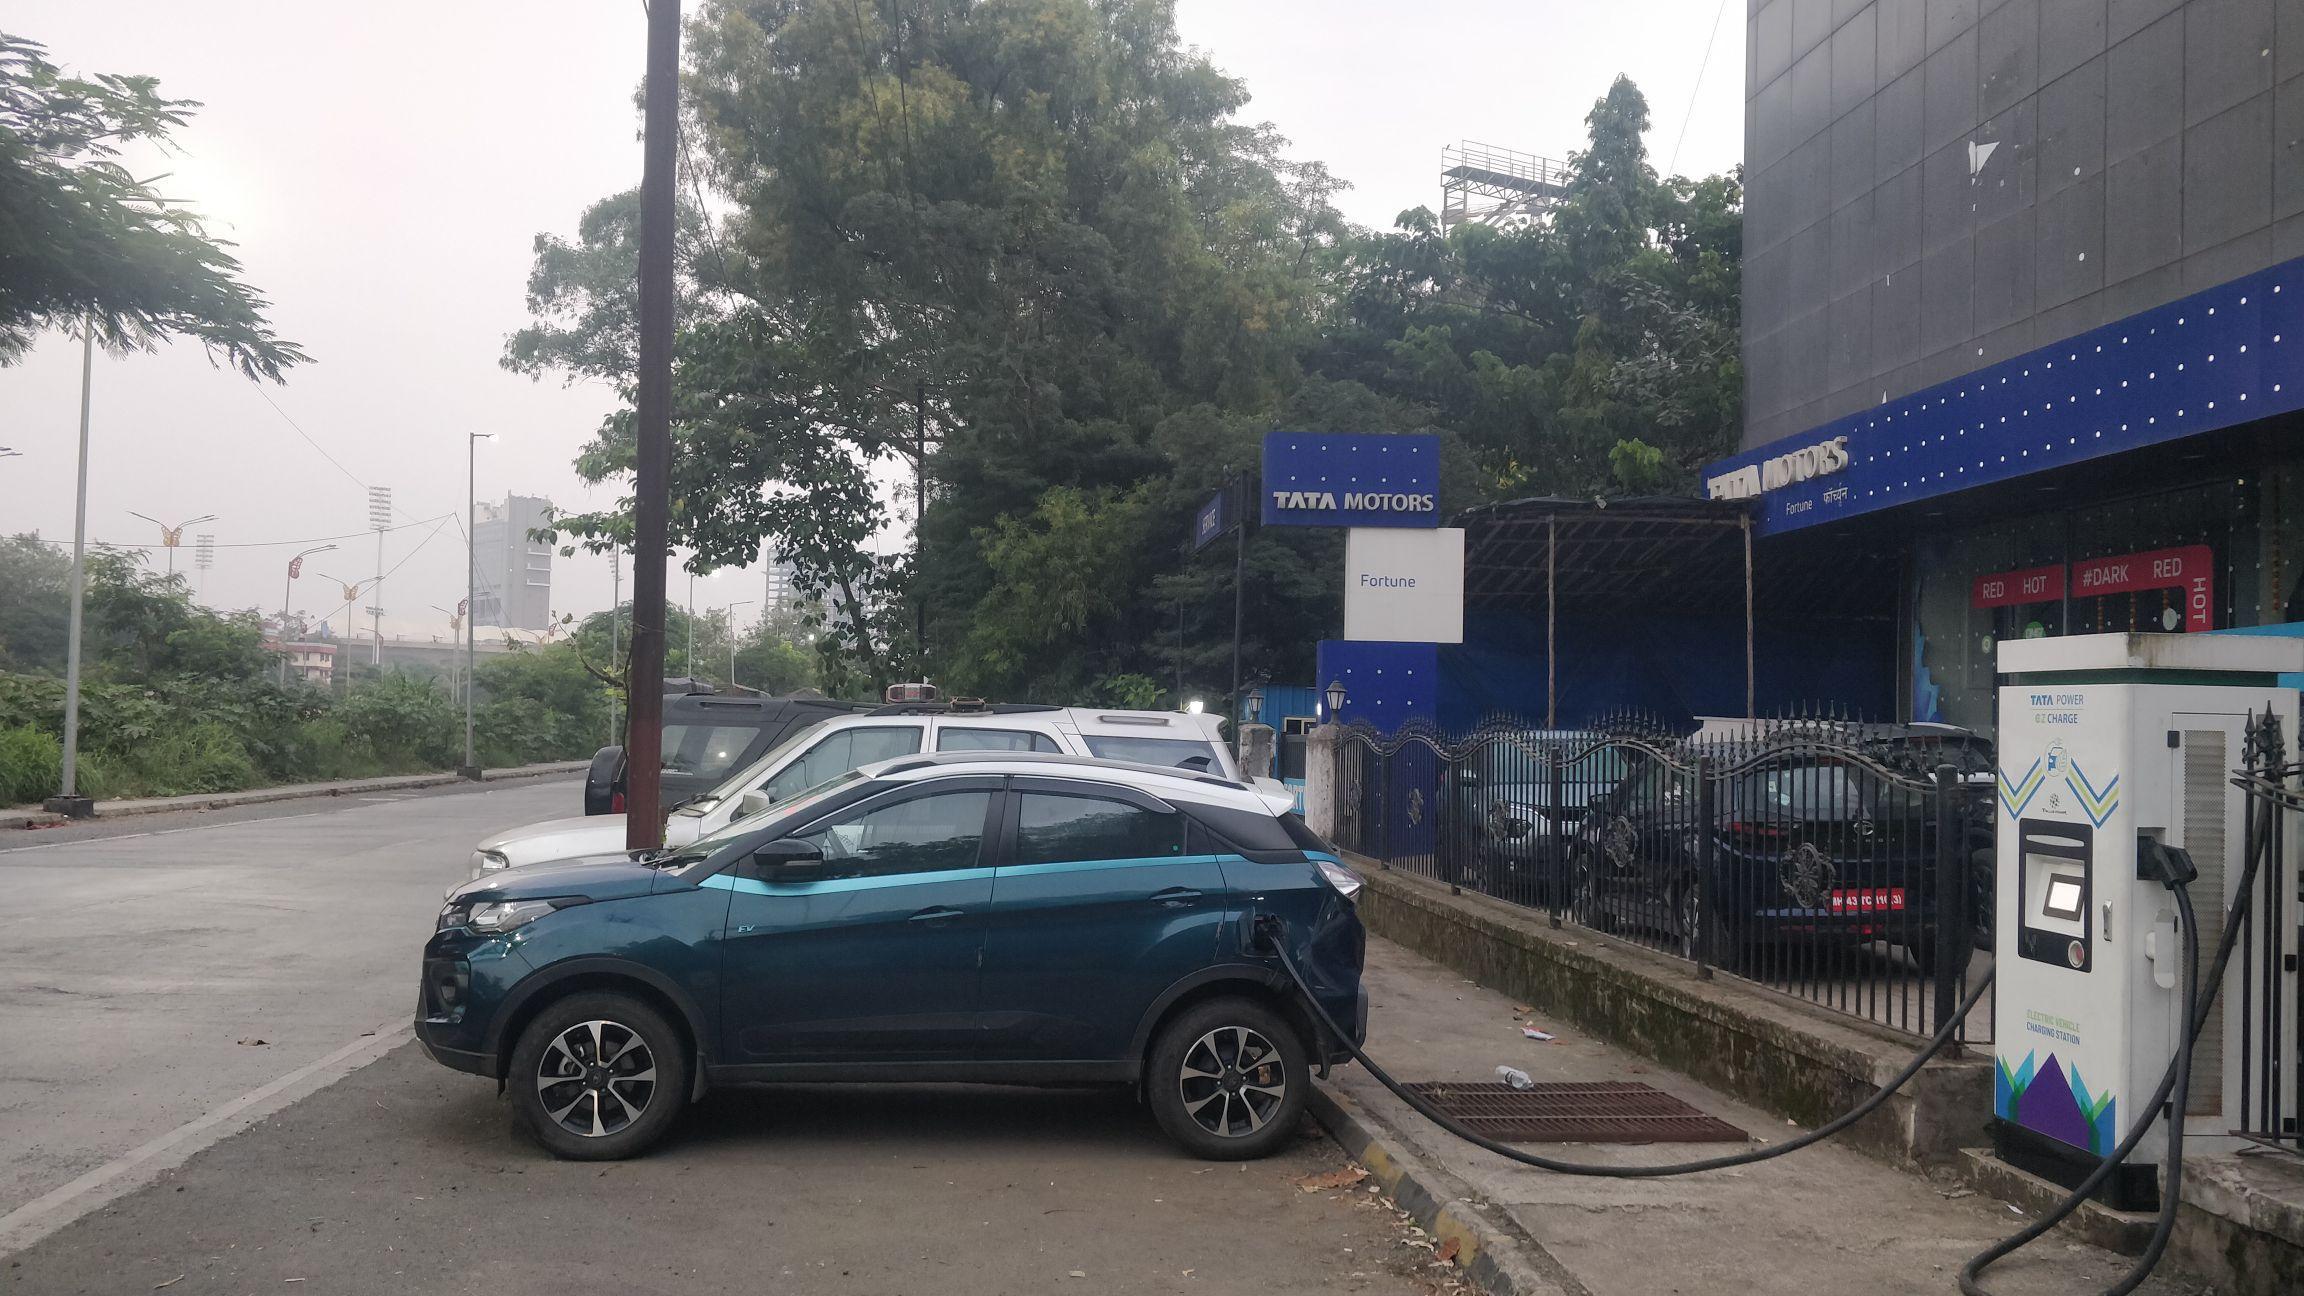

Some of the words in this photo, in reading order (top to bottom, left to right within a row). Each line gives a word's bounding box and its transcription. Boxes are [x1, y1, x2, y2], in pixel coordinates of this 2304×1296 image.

[1762, 436, 1849, 492] MOTORS
[1273, 491, 1337, 510] TATA
[1344, 492, 1434, 512] MOTORS
[1786, 500, 1813, 515] Fortune
[1360, 574, 1416, 587] Fortune
[1983, 580, 2004, 599] RED
[2024, 576, 2047, 595] HOT
[2083, 564, 2129, 587] #DARK
[2153, 557, 2182, 579] RED
[2193, 577, 2207, 624] HOT
[2031, 694, 2053, 706] TATA
[2056, 694, 2084, 705] POWER
[2047, 713, 2078, 724] CHARGE
[1846, 896, 1858, 906] 43
[738, 924, 755, 933] EV
[2055, 1017, 2080, 1033] VEHICLE
[2026, 1021, 2055, 1038] CHARGING
[2055, 1030, 2080, 1046] STATION
